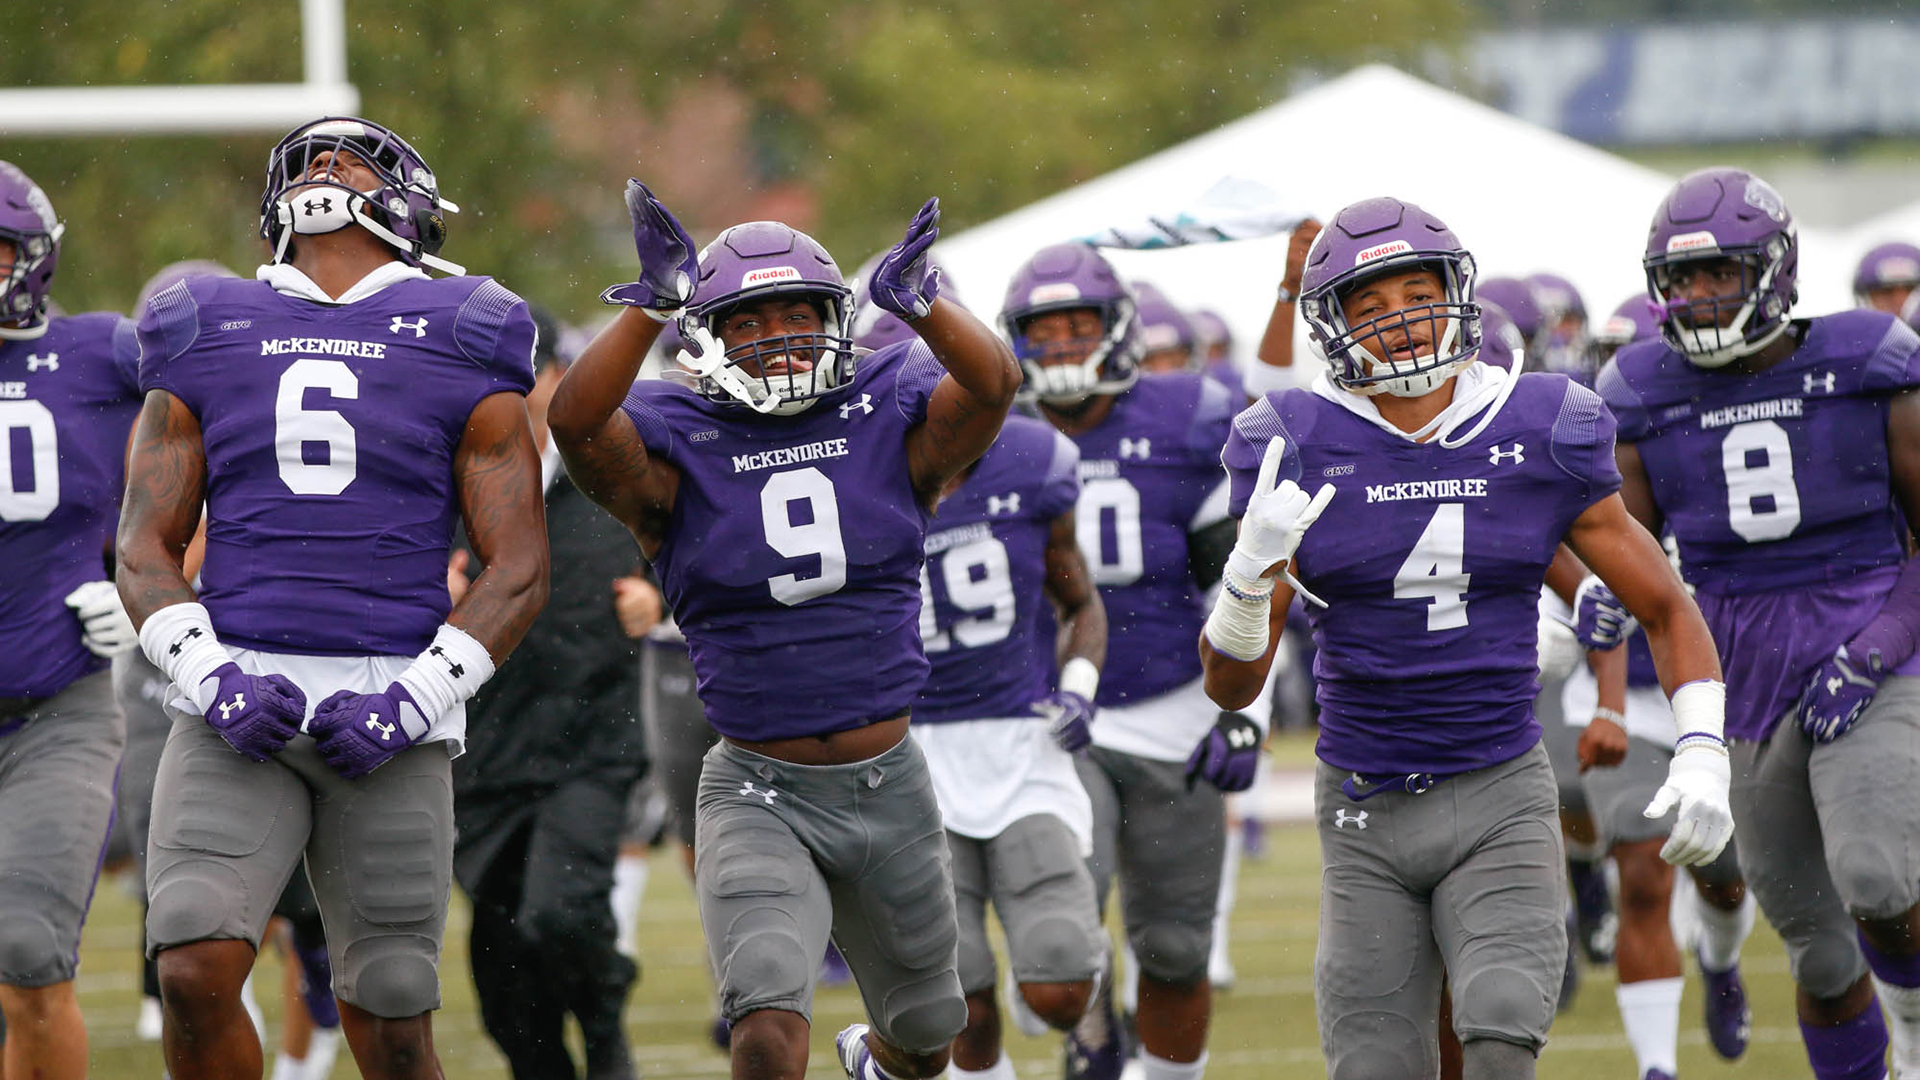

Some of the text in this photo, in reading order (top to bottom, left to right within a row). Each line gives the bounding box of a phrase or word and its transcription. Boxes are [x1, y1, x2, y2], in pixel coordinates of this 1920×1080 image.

[1361, 244, 1405, 261] Riddell
[749, 269, 794, 282] Riddell
[261, 337, 386, 359] McKENDREE
[275, 358, 359, 496] 6
[1701, 398, 1804, 429] McKENDREE
[732, 438, 849, 473] McKENDREE
[1365, 479, 1488, 503] McKENDREE
[1722, 419, 1801, 544] 8
[760, 466, 847, 606] 9
[1393, 503, 1472, 632] 4
[919, 537, 1016, 652] 19
